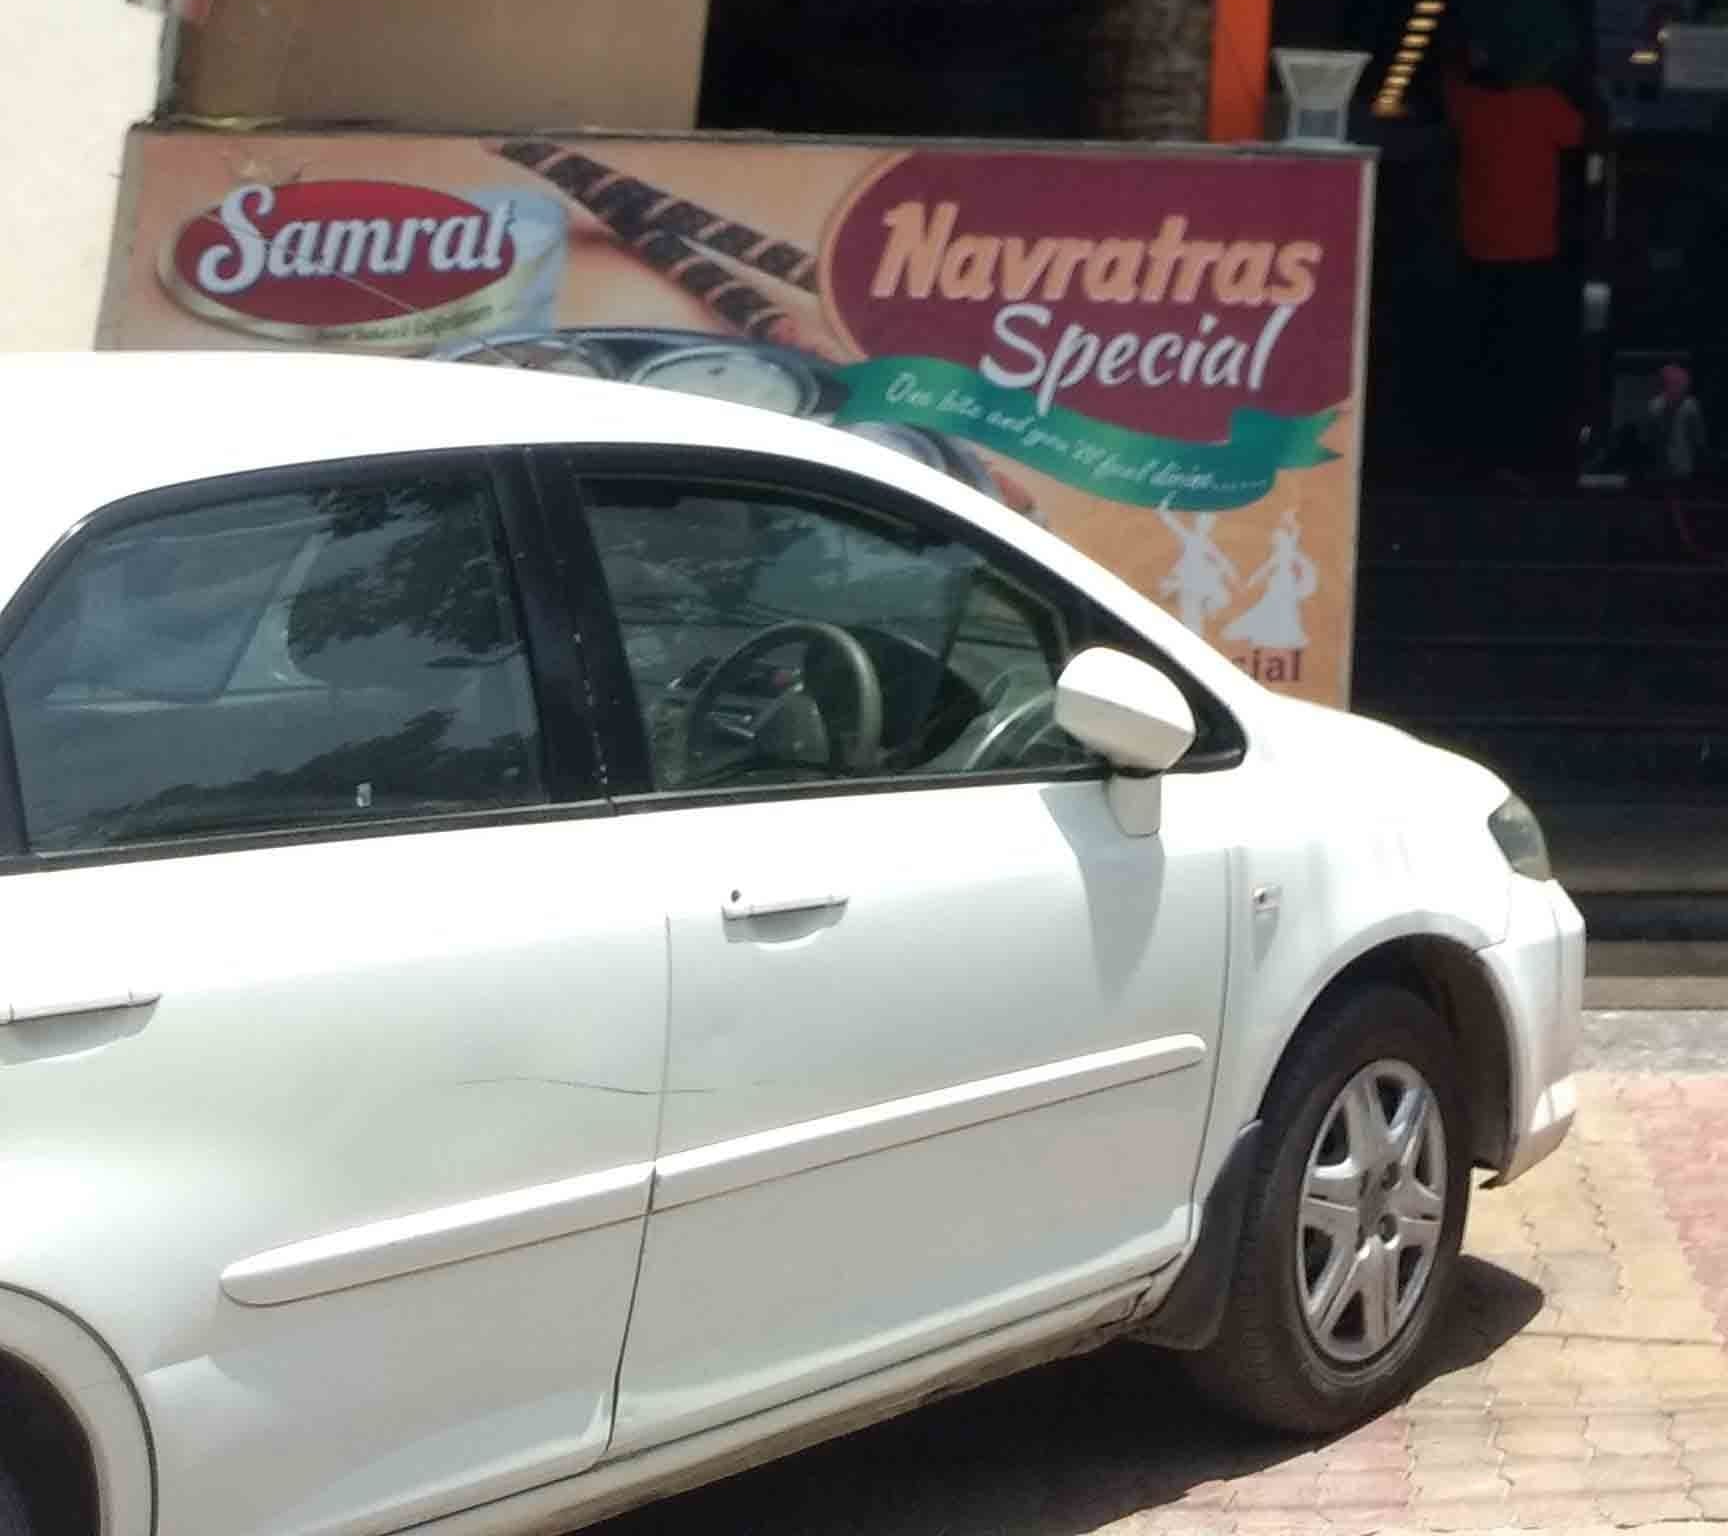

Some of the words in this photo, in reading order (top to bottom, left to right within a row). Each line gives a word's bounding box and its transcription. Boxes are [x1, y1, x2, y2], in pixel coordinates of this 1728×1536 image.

[197, 182, 516, 294] Samrat
[869, 200, 1324, 306] Navratras
[978, 300, 1297, 417] Special
